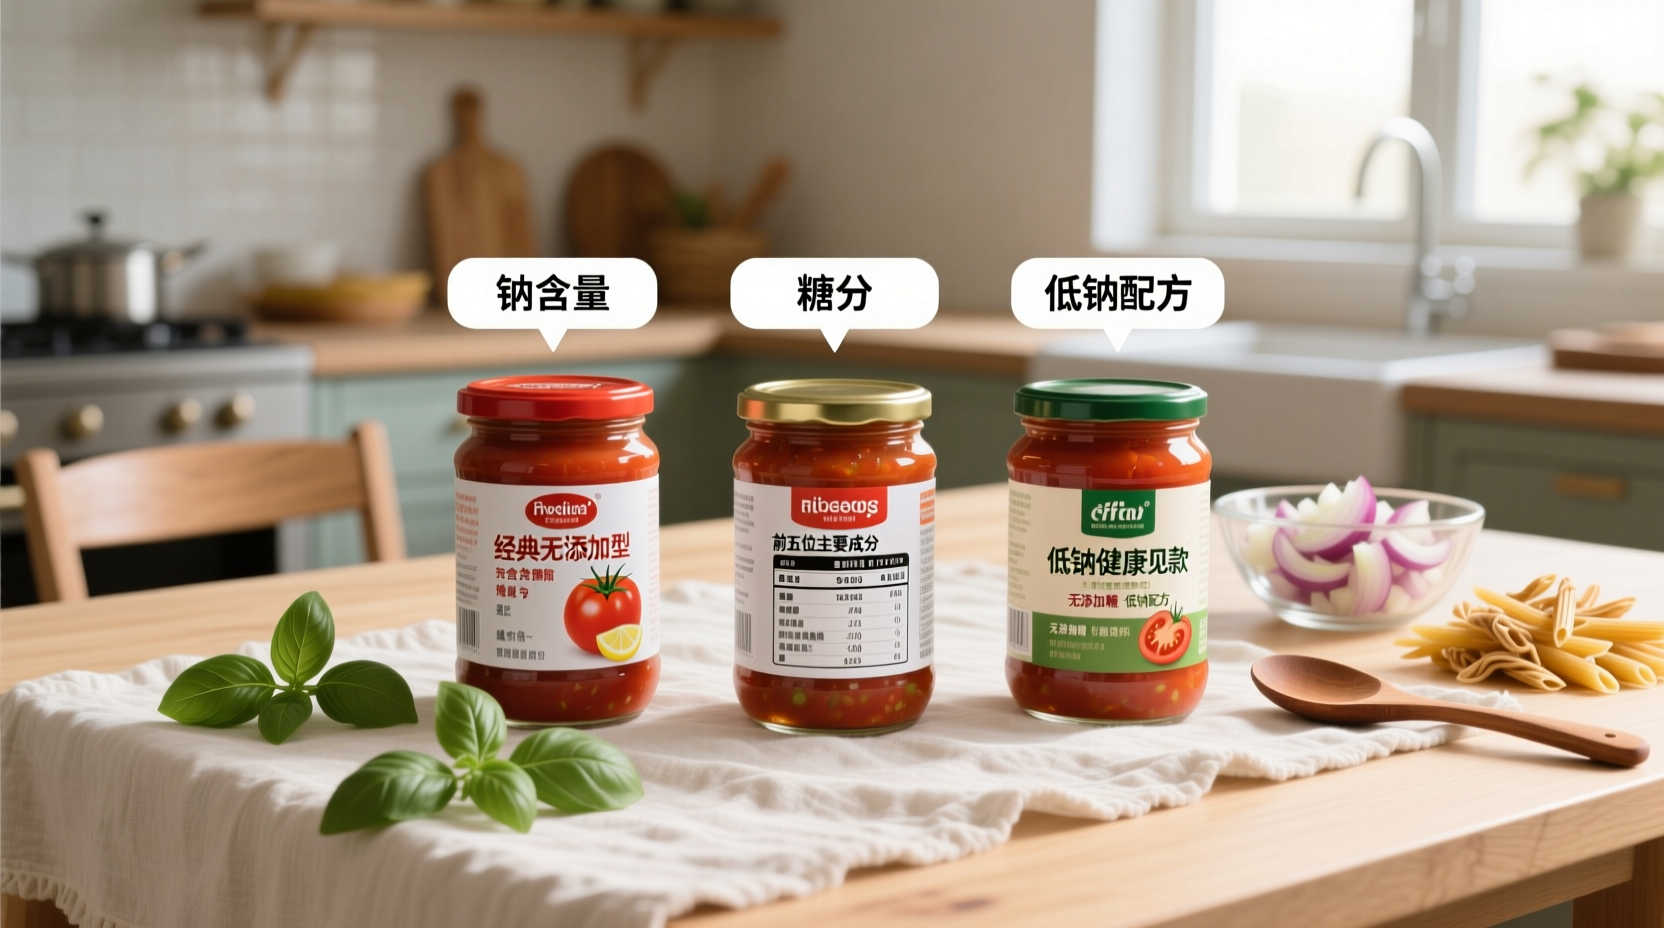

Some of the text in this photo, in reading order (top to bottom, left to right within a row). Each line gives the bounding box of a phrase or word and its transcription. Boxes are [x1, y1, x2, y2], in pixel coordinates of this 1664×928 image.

[494, 531, 631, 562] 经典无添加型
[771, 533, 879, 552] 前五位主要成分
[1047, 546, 1189, 576] 低钠健康见款
